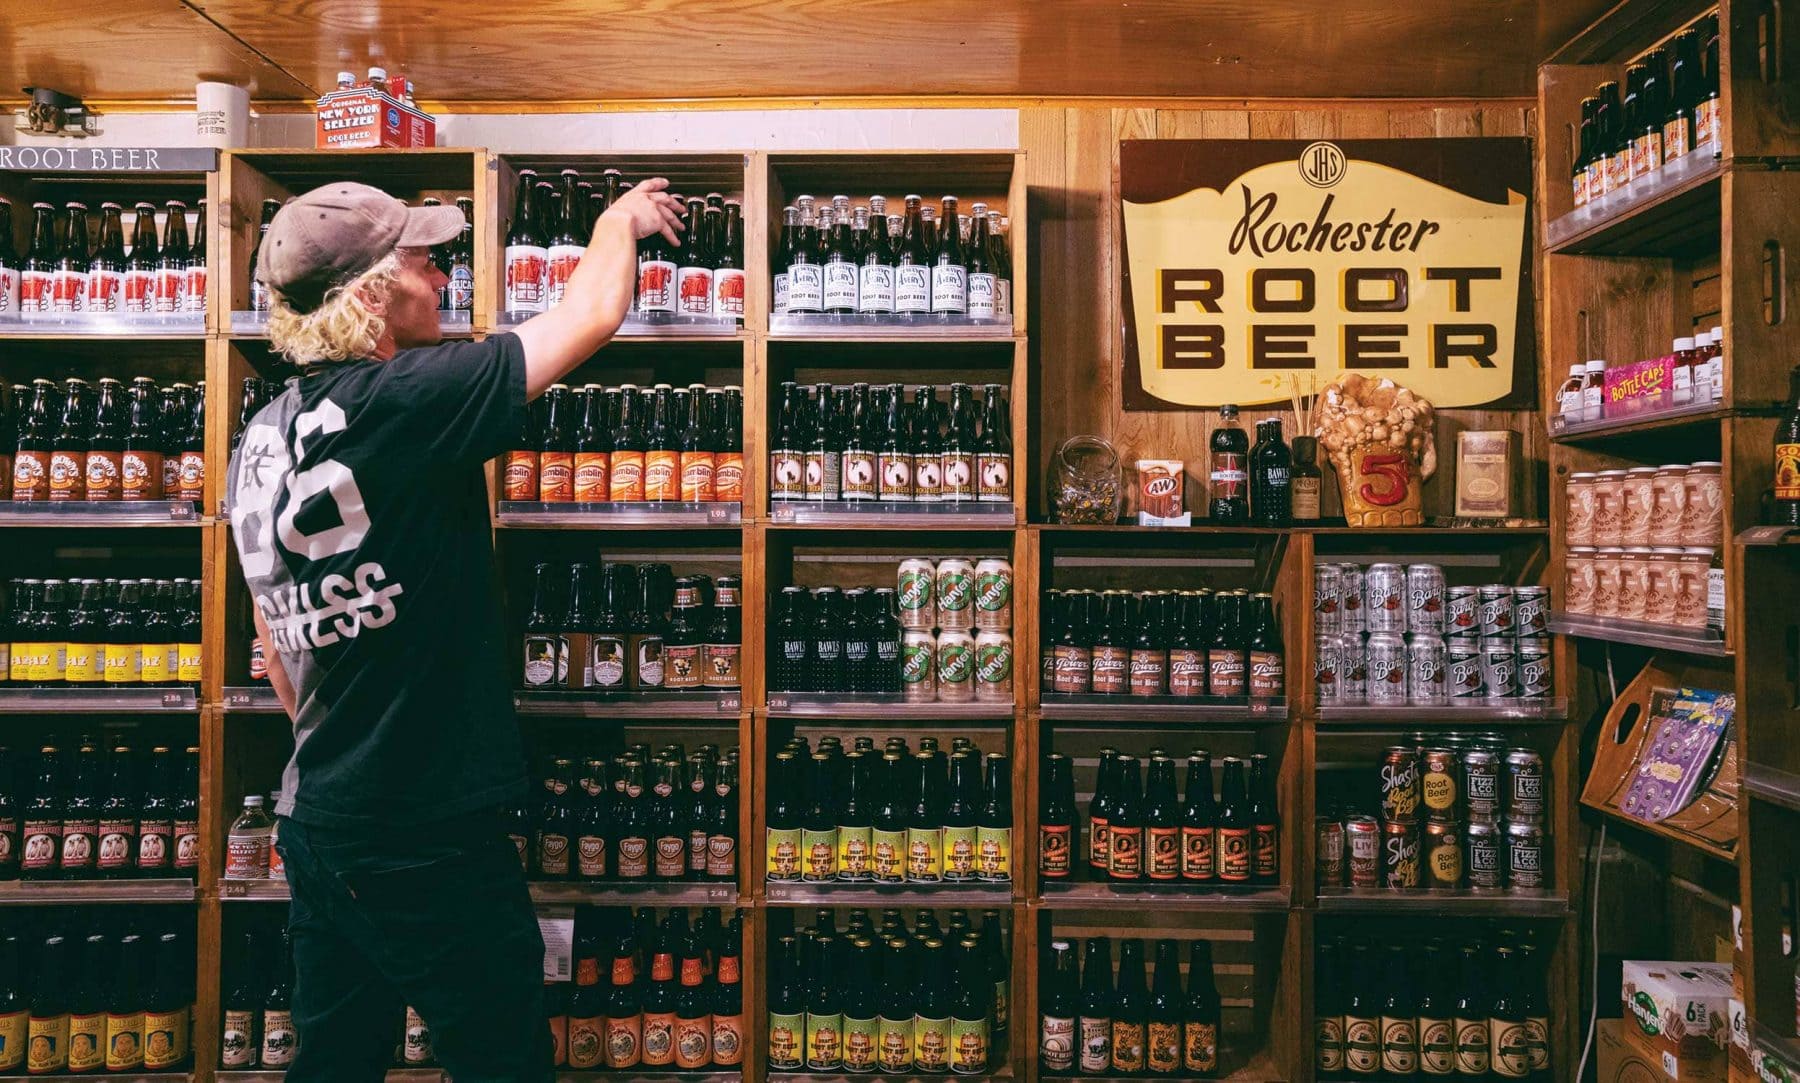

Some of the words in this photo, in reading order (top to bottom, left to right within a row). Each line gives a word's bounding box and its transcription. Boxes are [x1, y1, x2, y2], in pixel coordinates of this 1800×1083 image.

[332, 98, 366, 108] ORIGINAL
[319, 107, 344, 120] NEW
[348, 104, 381, 116] YORK
[324, 116, 375, 131] SELTZER
[327, 133, 348, 143] ROOT
[0, 148, 78, 169] ROOT
[91, 149, 160, 170] BEER
[1309, 147, 1338, 181] JHS
[1229, 183, 1439, 258] Rochester
[1156, 267, 1502, 313] ROOT
[1156, 323, 1498, 369] BEER
[1611, 372, 1641, 403] BOTTLE
[1641, 363, 1665, 387] CAPS
[1267, 467, 1290, 479] BAWLS
[1361, 455, 1408, 506] 5
[171, 507, 188, 515] 2.48
[711, 510, 727, 518] 1.98
[785, 641, 806, 652] BAWLS
[818, 641, 840, 652] BAWLS
[847, 642, 868, 653] BAWLS
[878, 641, 899, 652] BAWLS
[1426, 779, 1447, 789] Root
[1471, 777, 1493, 786] FIZZ
[1518, 778, 1540, 786] FIZZ
[1428, 788, 1449, 798] Beer
[581, 840, 599, 852] Faygo
[624, 842, 643, 853] Faygo
[661, 841, 680, 852] Faygo
[711, 840, 730, 852] Faygo
[1474, 849, 1497, 858] FIZZ
[1514, 849, 1537, 858] FIZZ
[1686, 1001, 1696, 1022] 6
[1734, 1011, 1741, 1031] 6
